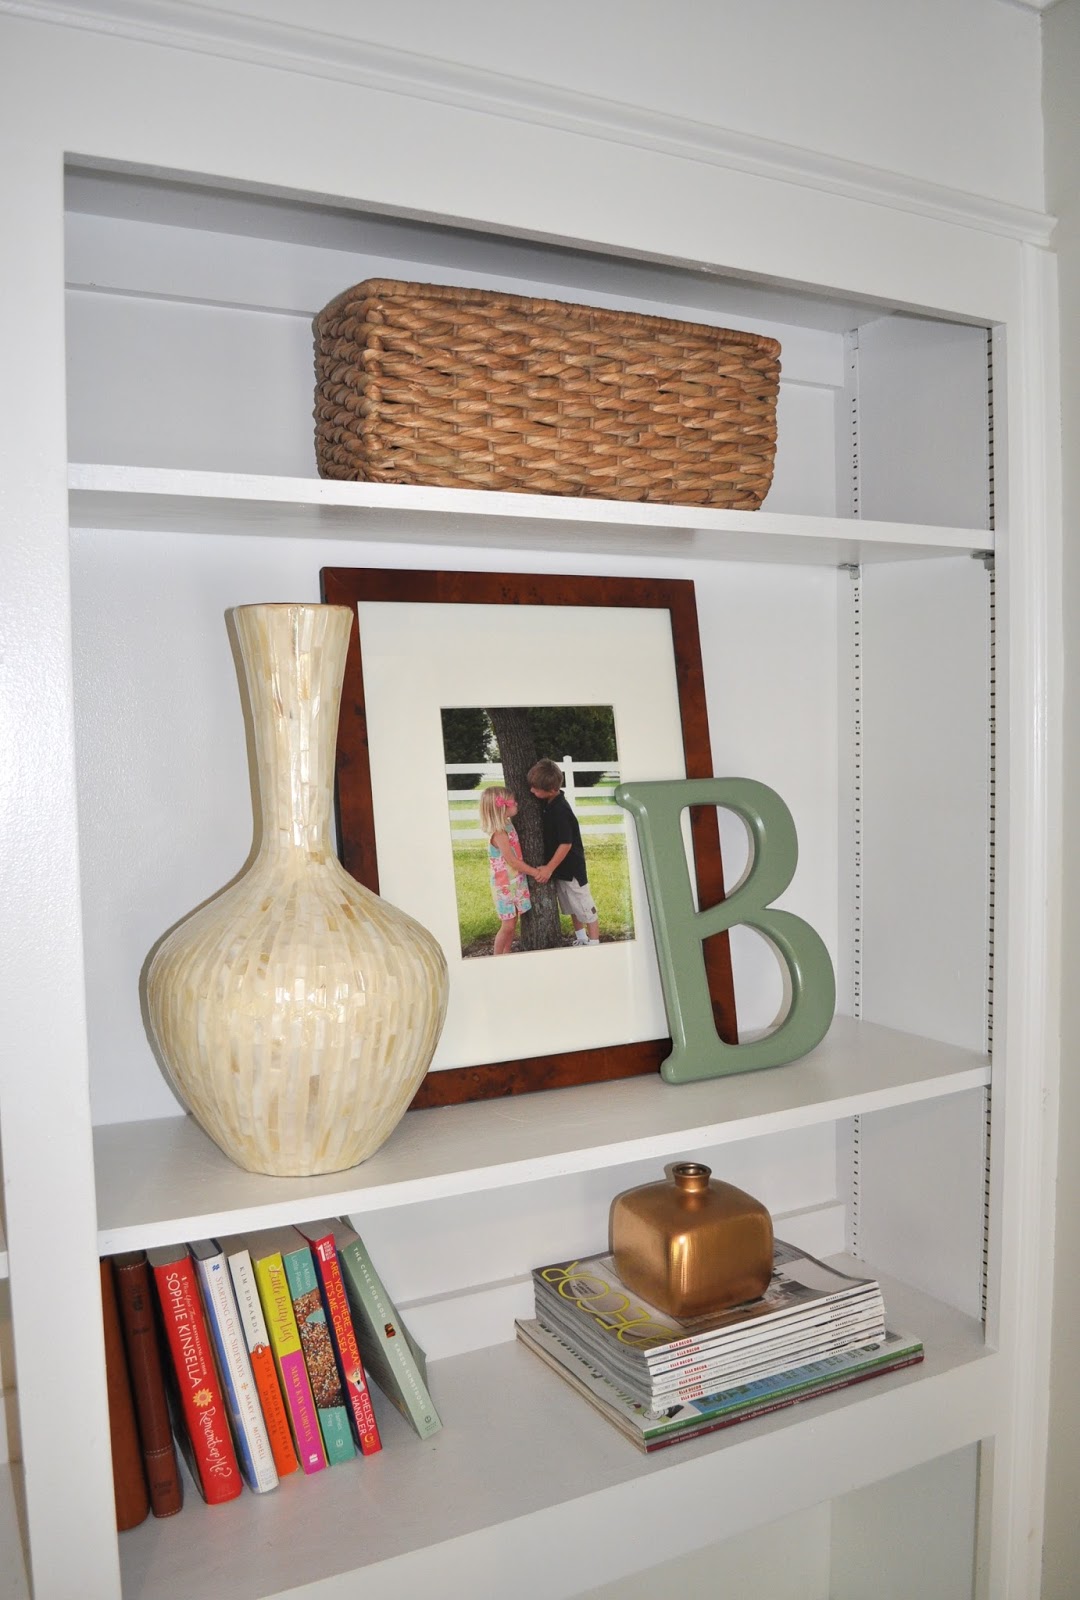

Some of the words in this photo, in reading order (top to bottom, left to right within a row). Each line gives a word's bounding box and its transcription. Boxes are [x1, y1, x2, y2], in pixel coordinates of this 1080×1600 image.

[614, 777, 836, 1084] B
[268, 1262, 284, 1295] Little
[291, 1256, 299, 1271] Little
[294, 1272, 303, 1291] Pieces
[330, 1261, 340, 1278] ARE
[353, 1247, 362, 1262] THE
[360, 1264, 372, 1283] CASE
[370, 1285, 379, 1301] FOR
[376, 1302, 386, 1318] GOD
[239, 1266, 247, 1284] KIM
[245, 1290, 258, 1334] EDWARDS
[335, 1278, 344, 1298] YOU
[541, 1261, 673, 1345] DECOR
[216, 1276, 230, 1316] STARTING
[225, 1317, 236, 1337] OUT
[231, 1337, 245, 1378] SIDEWAYS
[274, 1296, 288, 1323] Bitty
[325, 1281, 336, 1297] IT'S
[333, 1315, 347, 1354] CHELSEA
[339, 1298, 351, 1331] THERE,
[166, 1272, 188, 1322] SOPHIE
[178, 1323, 202, 1388] KINSELLA
[347, 1331, 360, 1365] VODKA?
[291, 1365, 301, 1388] MARY
[394, 1343, 407, 1366] KAREN
[405, 1369, 426, 1410] ARMSTRONG
[263, 1390, 276, 1435] DAUGHTER
[264, 1361, 272, 1377] THE
[270, 1382, 281, 1416] MEMORY
[278, 1420, 290, 1458] KEEPER'S
[295, 1389, 304, 1404] KAY
[351, 1395, 367, 1434] HANDLER
[360, 1392, 375, 1430] CHELSEA
[200, 1406, 223, 1458] Remember
[246, 1395, 254, 1416] MARY
[253, 1427, 264, 1460] MITCHELL
[299, 1406, 313, 1442] ANDREWS
[334, 1411, 343, 1431] James
[206, 1456, 232, 1478] Me?
